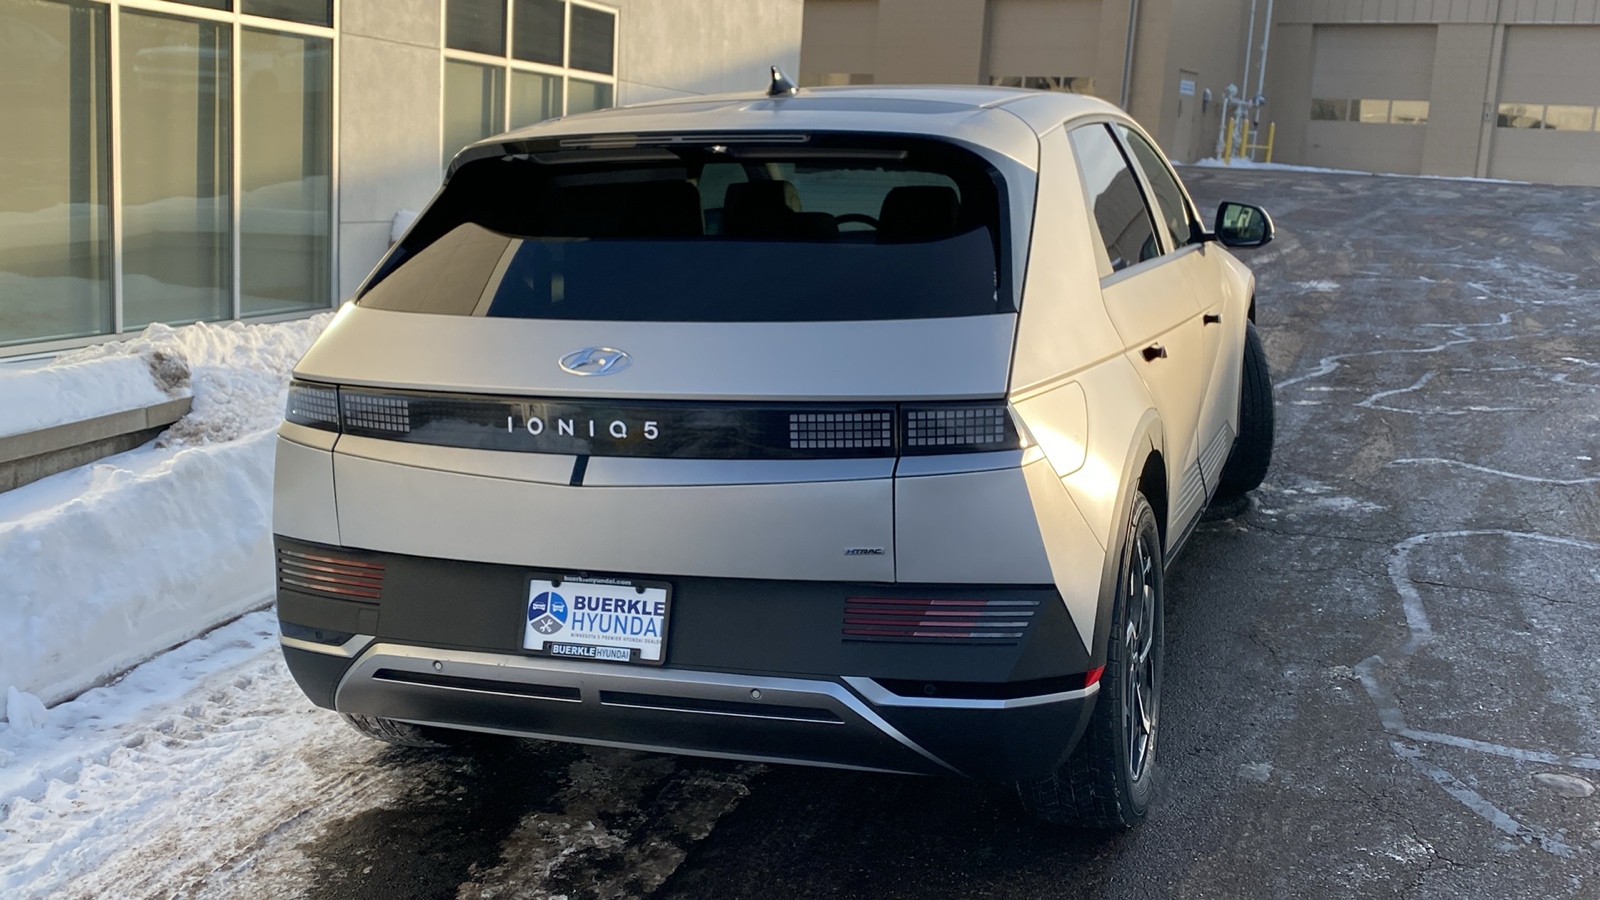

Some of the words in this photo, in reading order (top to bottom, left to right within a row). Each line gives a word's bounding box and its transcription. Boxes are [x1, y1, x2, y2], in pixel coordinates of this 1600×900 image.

[508, 416, 627, 439] IONIQ
[643, 421, 659, 440] 5
[573, 595, 665, 616] BUERKLE
[552, 644, 596, 657] BUERKLE
[596, 649, 629, 660] HYUNDAI
